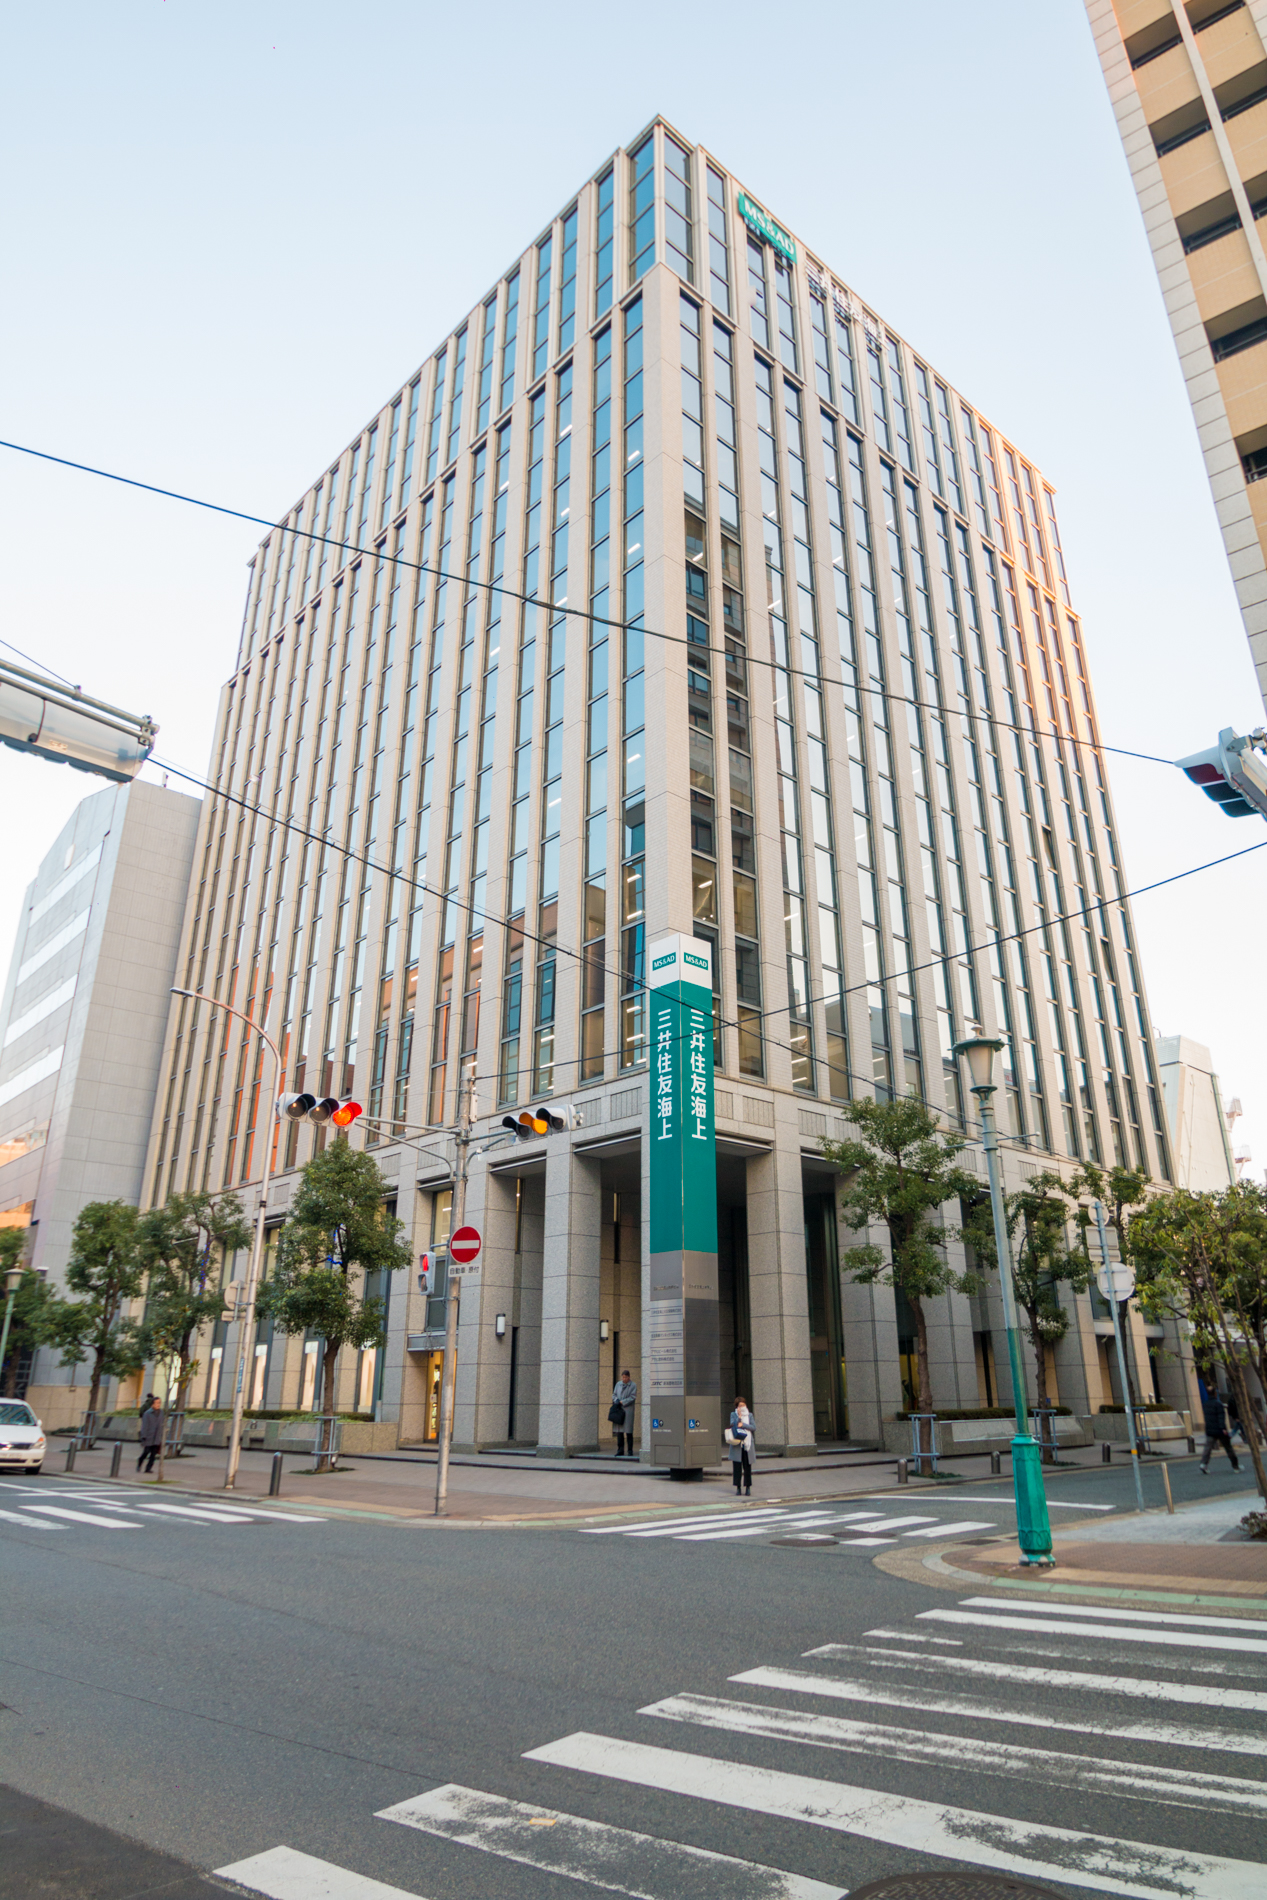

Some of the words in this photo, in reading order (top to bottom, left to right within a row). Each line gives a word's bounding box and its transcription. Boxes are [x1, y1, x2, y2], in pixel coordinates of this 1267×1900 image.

[744, 200, 794, 255] MS&AD
[653, 954, 675, 968] MS&AD
[685, 954, 708, 969] MS&AD
[657, 1008, 673, 1140] 三井住友海上
[689, 1008, 708, 1141] 三井住友海上
